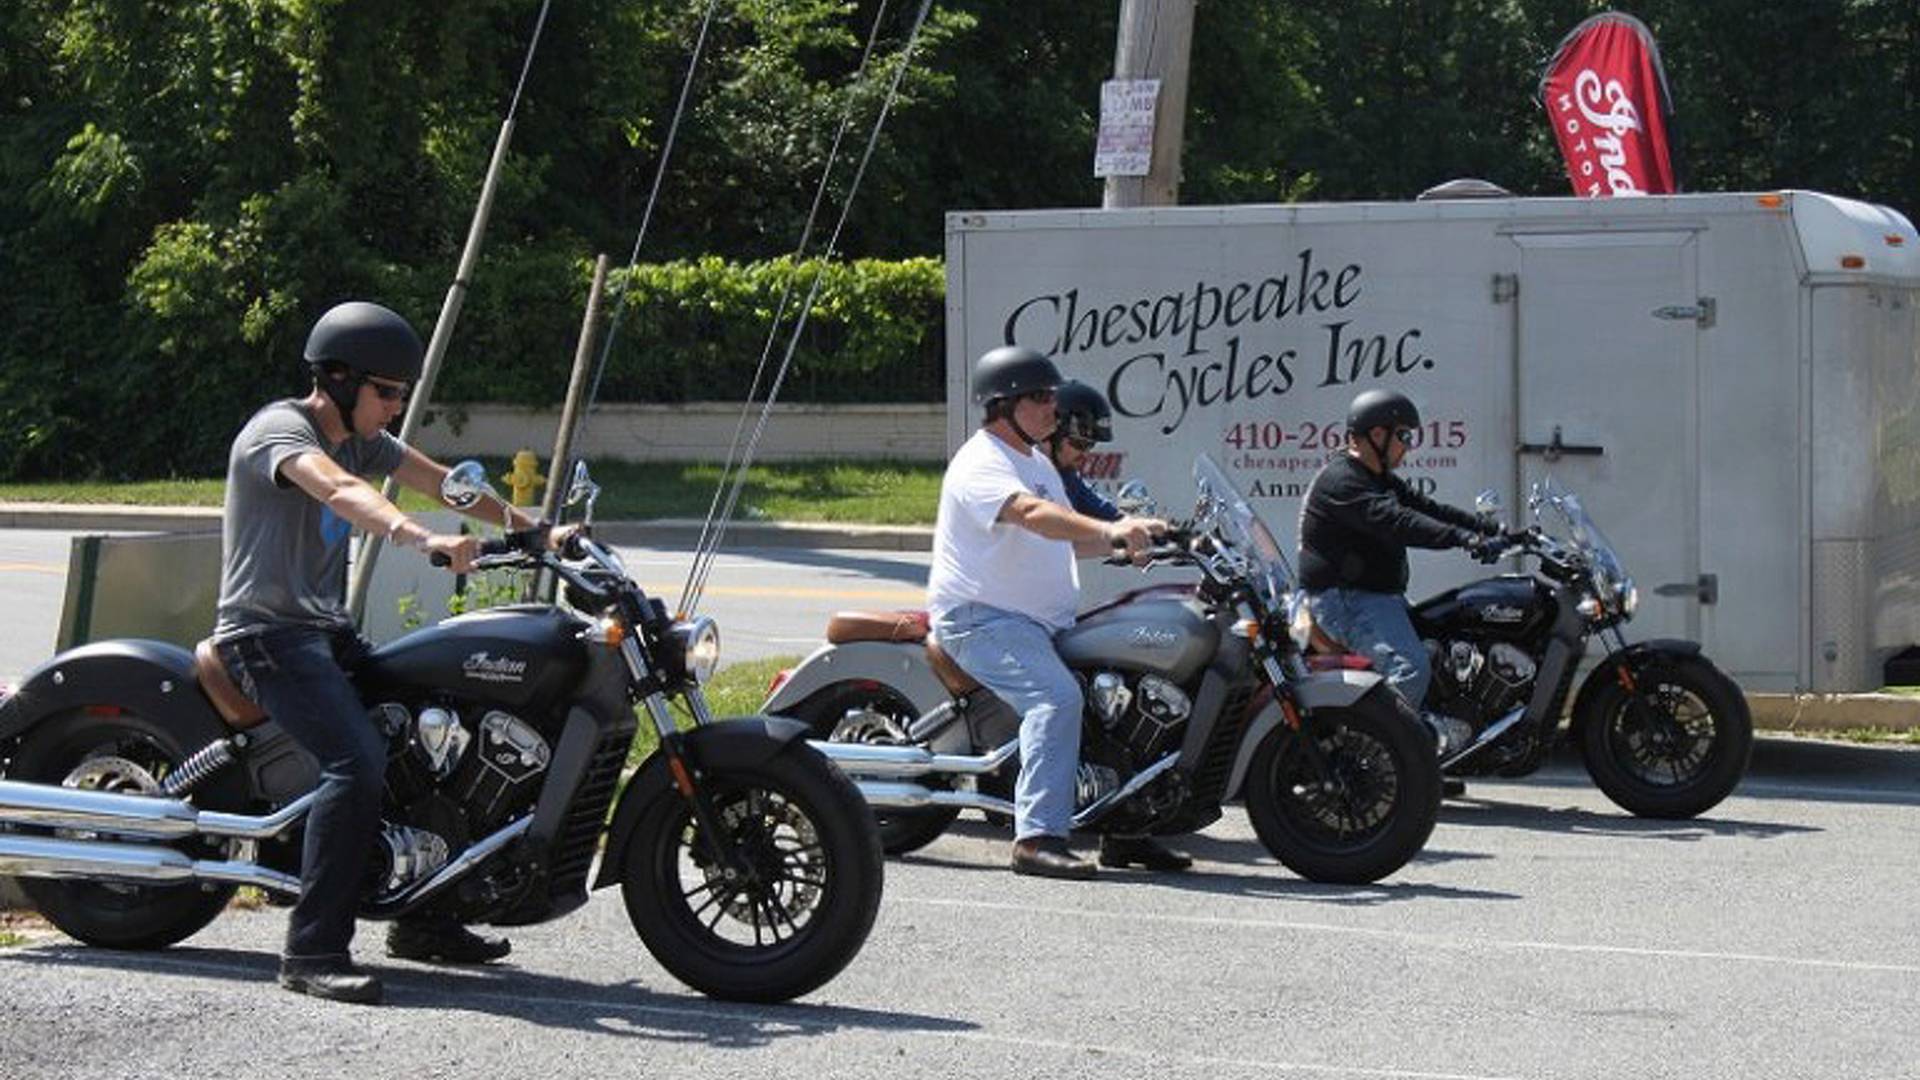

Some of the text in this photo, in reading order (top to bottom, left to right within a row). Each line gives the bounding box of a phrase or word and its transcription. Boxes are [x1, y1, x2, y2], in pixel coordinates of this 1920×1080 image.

[1557, 94, 1601, 198] MOTOR
[1574, 69, 1648, 197] Ind
[1003, 247, 1362, 358] Chesapeake
[1107, 319, 1436, 434] Cycles Inc.
